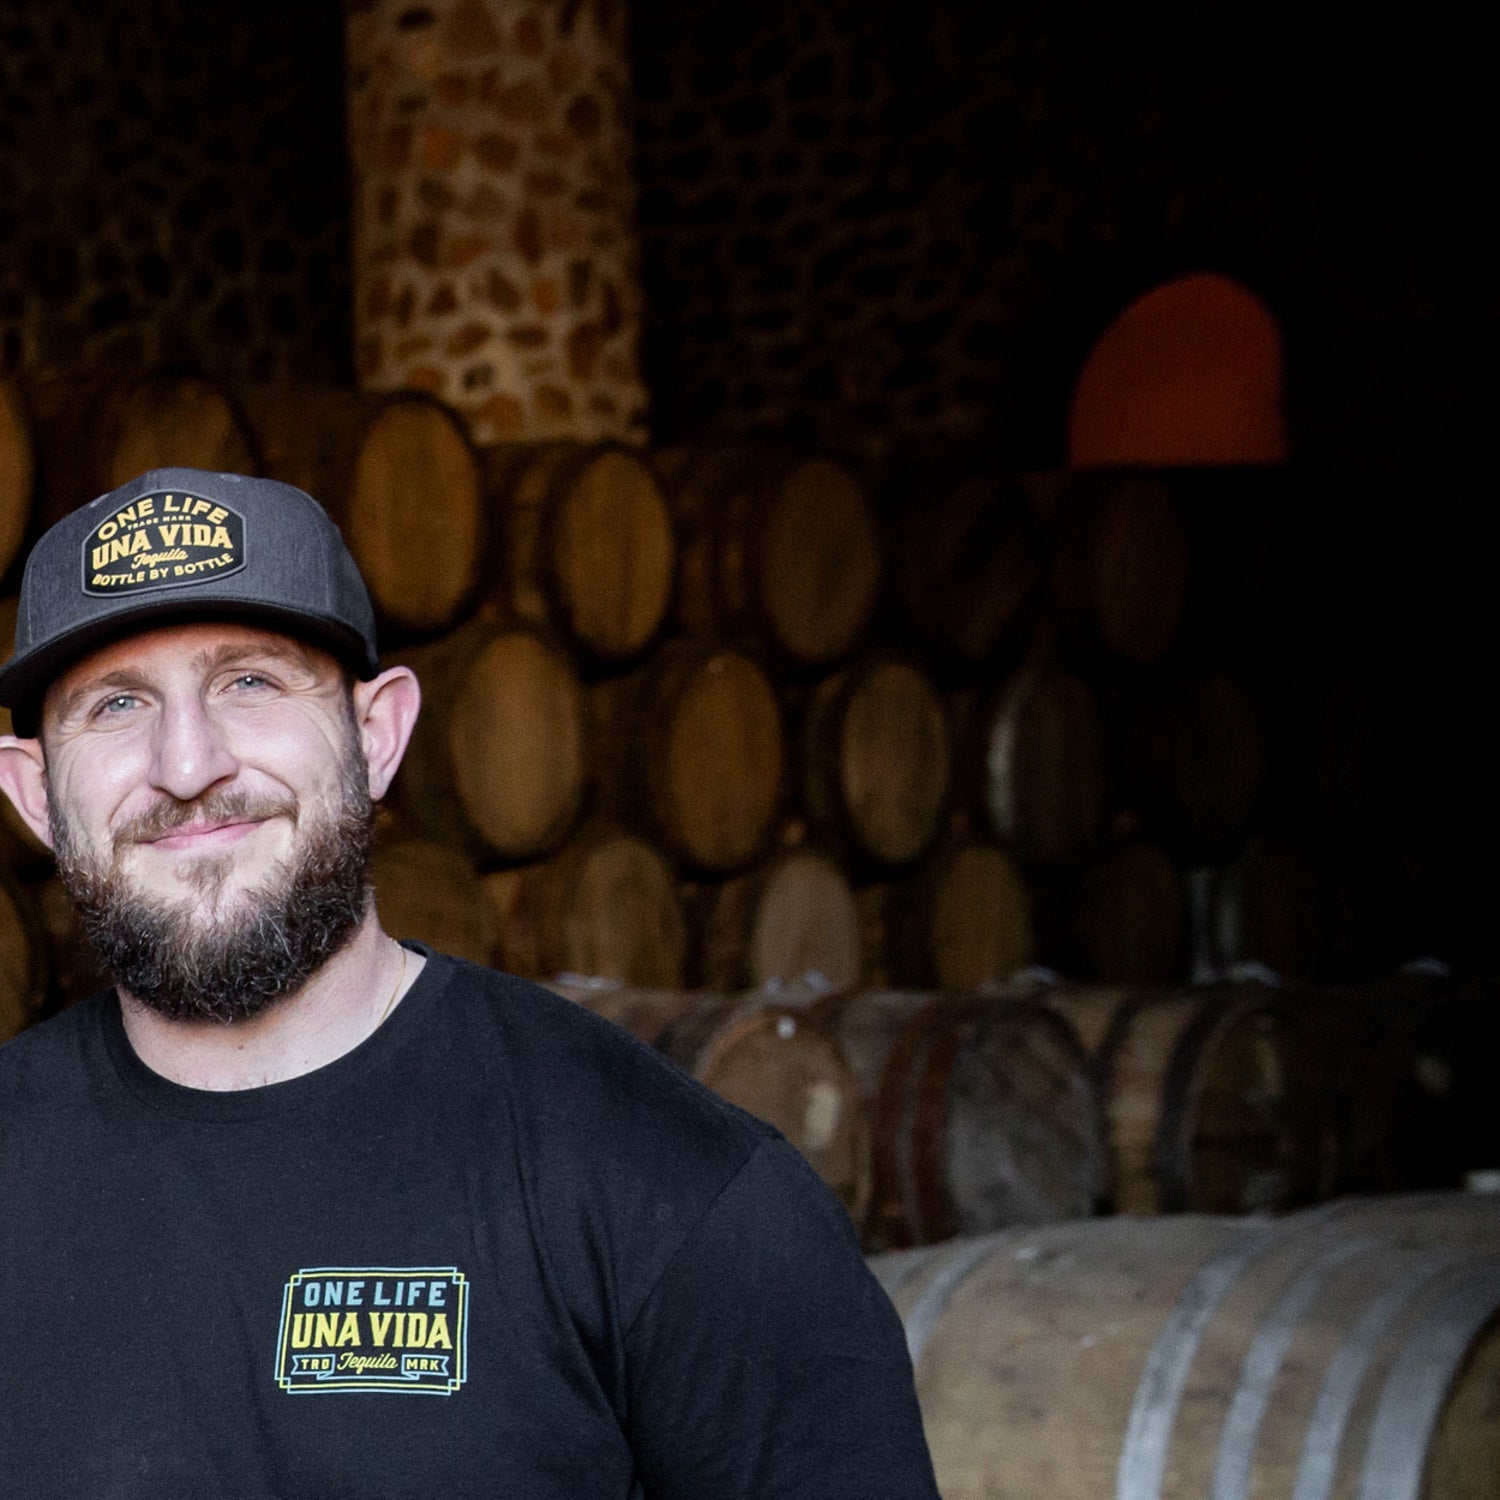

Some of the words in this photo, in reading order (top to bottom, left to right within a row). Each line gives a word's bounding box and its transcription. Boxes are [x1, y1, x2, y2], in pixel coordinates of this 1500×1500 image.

[98, 498, 155, 541] ONE
[164, 495, 229, 525] LIFE
[92, 529, 152, 570] UNA
[158, 524, 234, 549] VIDA
[131, 548, 189, 570] Tequila
[92, 571, 146, 586] BOTTLE
[150, 567, 169, 581] BY
[174, 552, 234, 576] BOTTLE
[304, 1281, 365, 1307] ONE
[373, 1281, 448, 1307] LIFE
[291, 1312, 362, 1349] UNA
[369, 1312, 453, 1350] VIDA
[301, 1358, 330, 1370] TRD
[337, 1352, 398, 1374] Tequila
[406, 1358, 439, 1371] MRK
